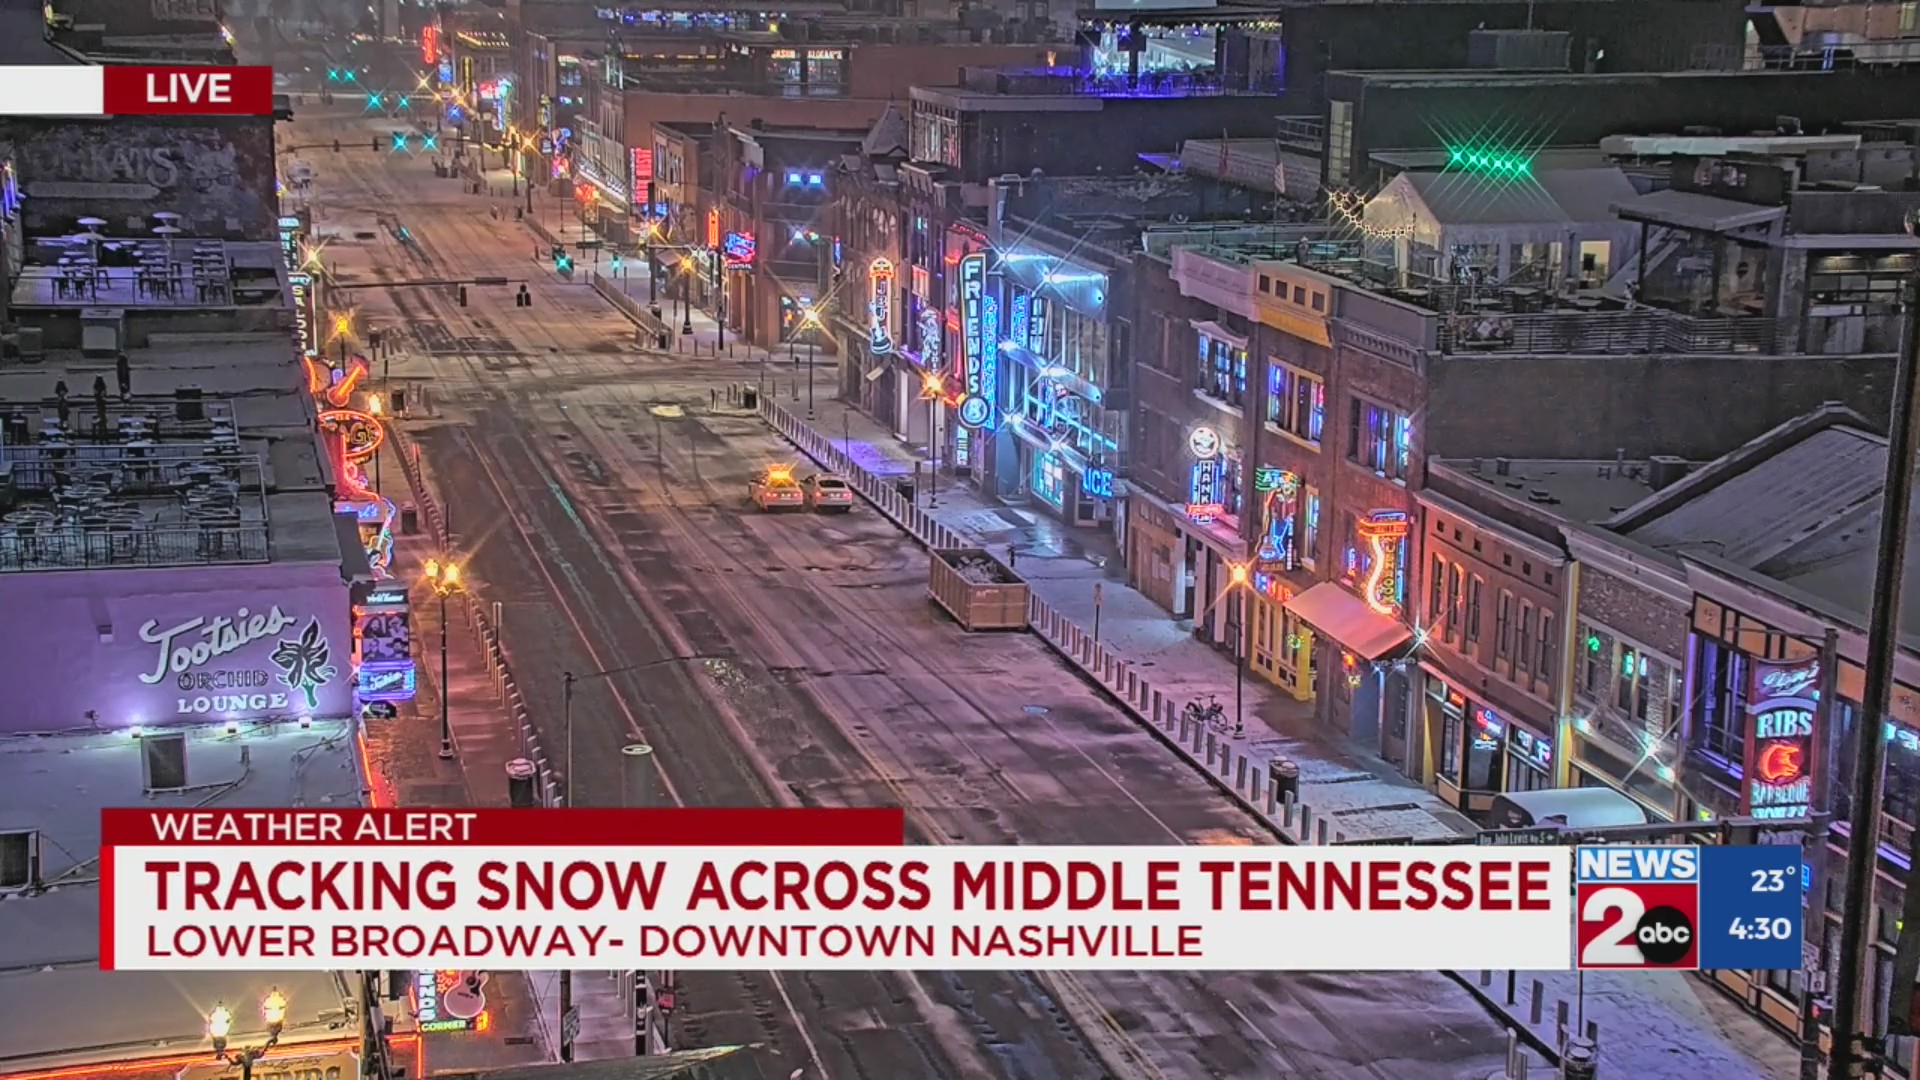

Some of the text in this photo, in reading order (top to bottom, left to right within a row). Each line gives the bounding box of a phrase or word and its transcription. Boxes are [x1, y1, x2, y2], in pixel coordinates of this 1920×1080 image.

[965, 261, 980, 393] FRIENDS
[1201, 462, 1211, 504] HANK
[139, 604, 297, 684] Tootsies
[177, 669, 268, 691] ORCHID
[177, 693, 288, 713] LOUNGE
[1756, 710, 1812, 738] RIBS
[1751, 776, 1810, 806] BARBEQUE
[419, 969, 435, 1020] ENDS
[421, 1020, 466, 1032] CORNER
